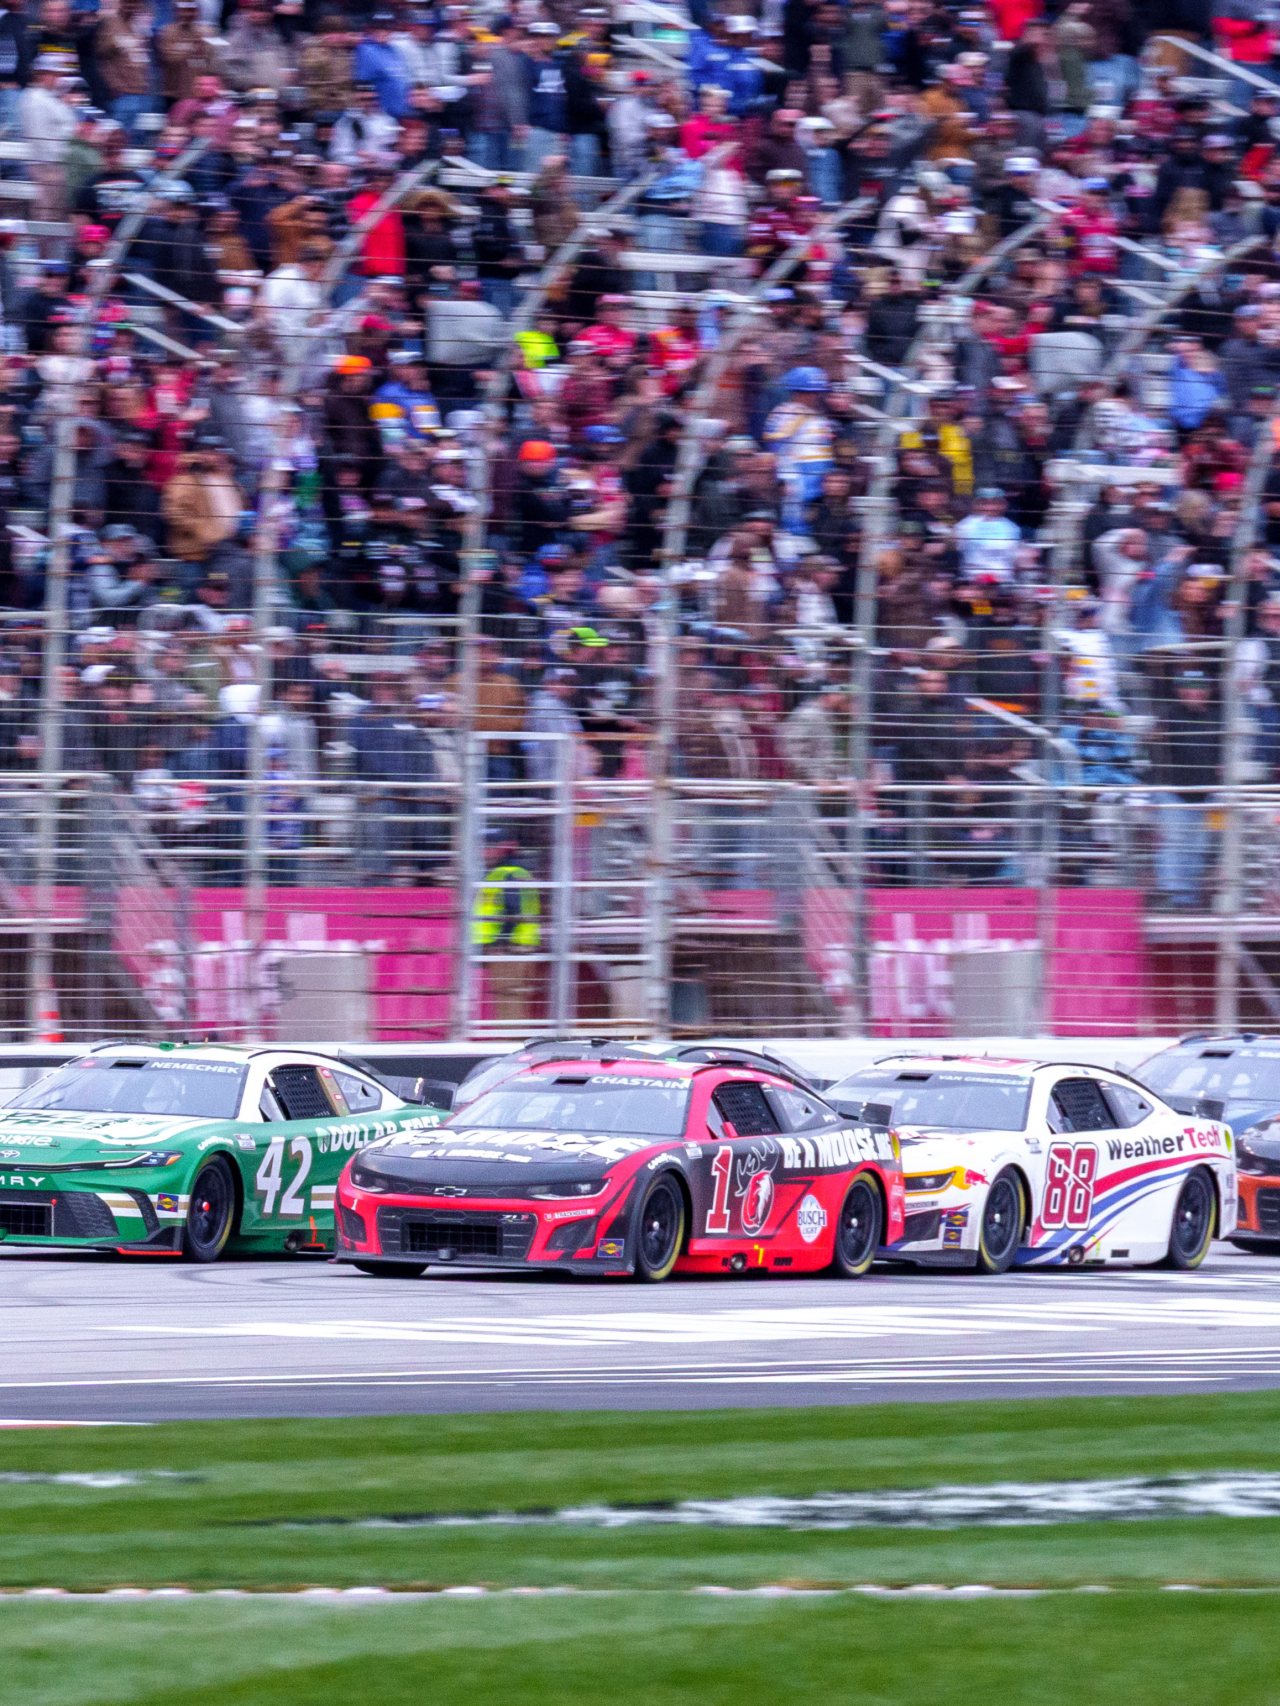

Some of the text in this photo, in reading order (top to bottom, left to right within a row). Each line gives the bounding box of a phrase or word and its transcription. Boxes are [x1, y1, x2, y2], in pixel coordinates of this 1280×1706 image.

[151, 1061, 240, 1075] NEMECHEK
[591, 1076, 690, 1089] CHASTAIN
[775, 1137, 801, 1168] BE
[255, 1136, 313, 1217] 42
[705, 1146, 733, 1233] 1
[1042, 1143, 1098, 1230] 88
[797, 1210, 827, 1226] BUSCH
